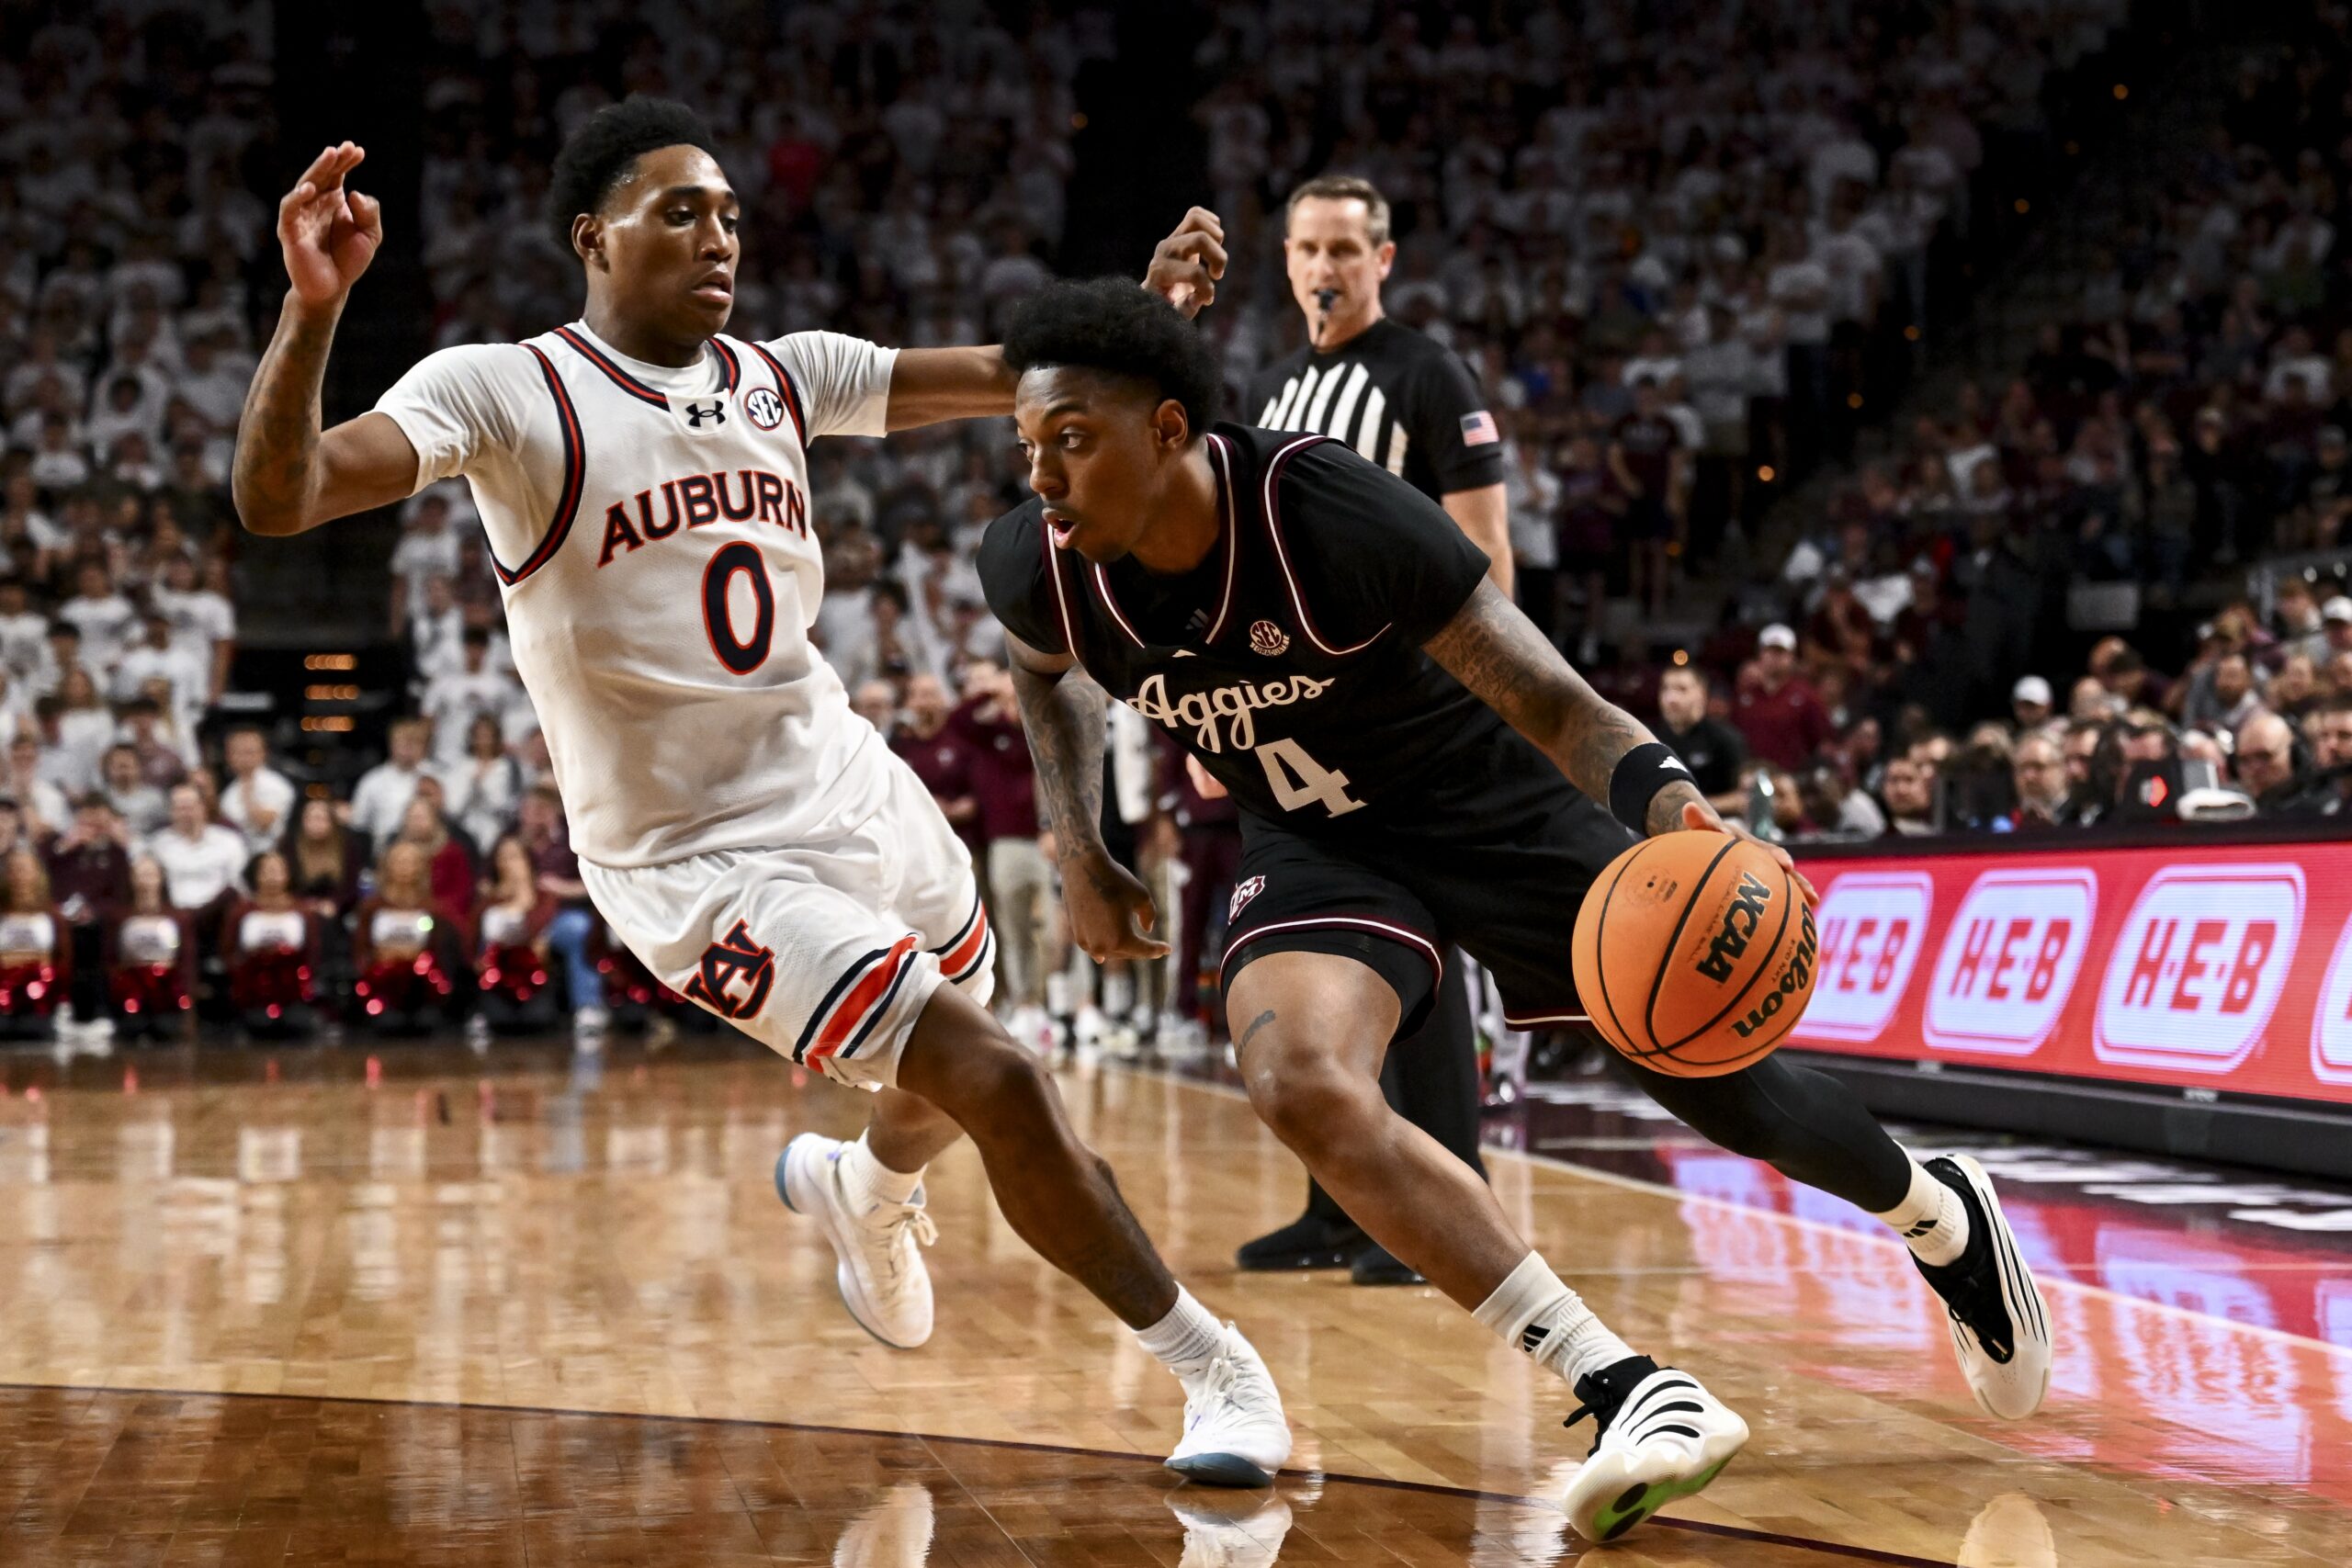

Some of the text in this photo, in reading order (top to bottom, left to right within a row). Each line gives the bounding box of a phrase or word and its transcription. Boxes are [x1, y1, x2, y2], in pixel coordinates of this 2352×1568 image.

[746, 389, 783, 428] SEC
[598, 470, 807, 569] AUBURN
[702, 540, 775, 675] 0
[1250, 621, 1283, 648] SEC
[1125, 673, 1336, 754] Aggies
[1253, 737, 1370, 819] 4
[1695, 871, 1771, 985] NCAA
[1731, 902, 1816, 1038] Wilson
